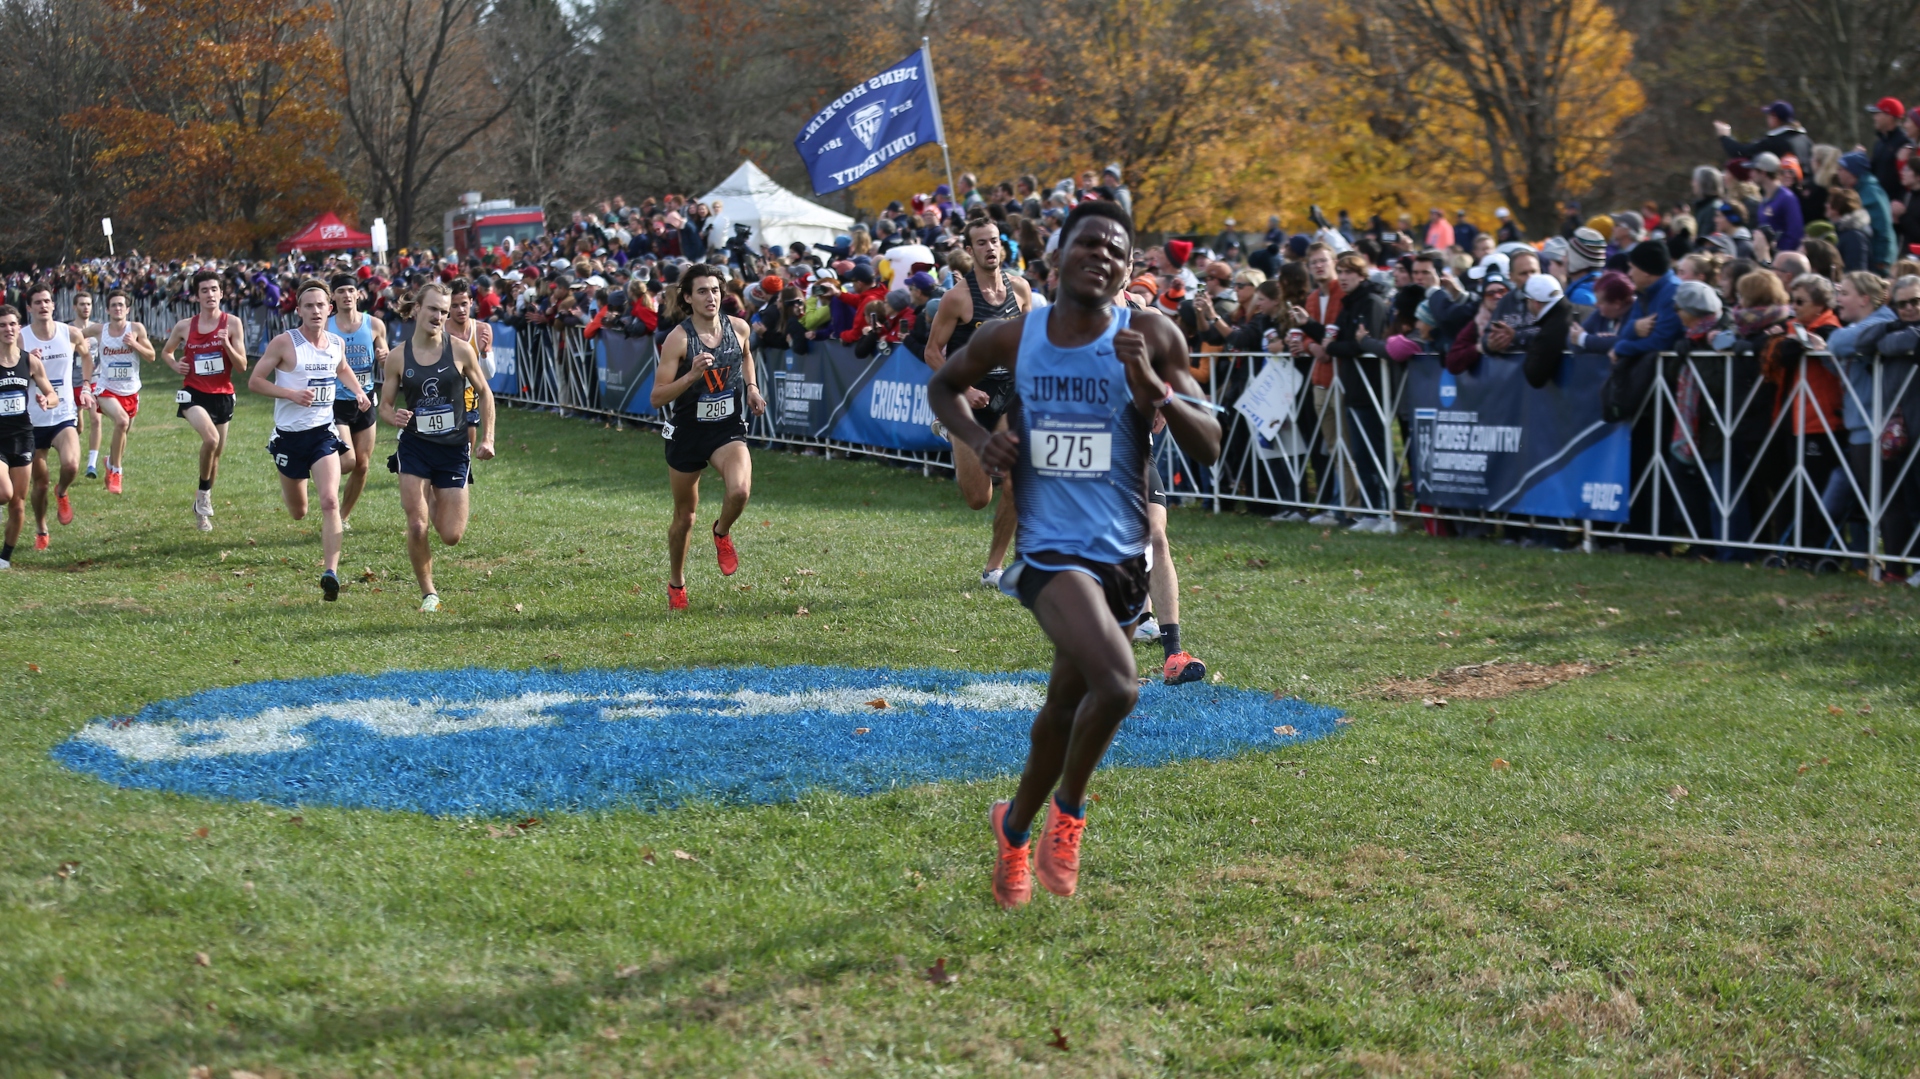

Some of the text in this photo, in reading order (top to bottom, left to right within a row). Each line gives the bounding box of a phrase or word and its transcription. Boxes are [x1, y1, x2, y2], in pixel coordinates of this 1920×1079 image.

[113, 367, 128, 378] 199
[203, 360, 215, 372] 41
[304, 363, 328, 371] GEORGE
[0, 377, 28, 388] SHKOSH
[703, 366, 731, 394] W
[314, 386, 332, 402] 102
[1030, 376, 1109, 405] JUMBOS
[3, 398, 21, 412] 349
[705, 400, 727, 418] 296
[870, 380, 912, 423] CROSS
[428, 415, 444, 430] 49
[1434, 424, 1523, 453] CROSS COUNTRY
[1046, 434, 1093, 469] 275
